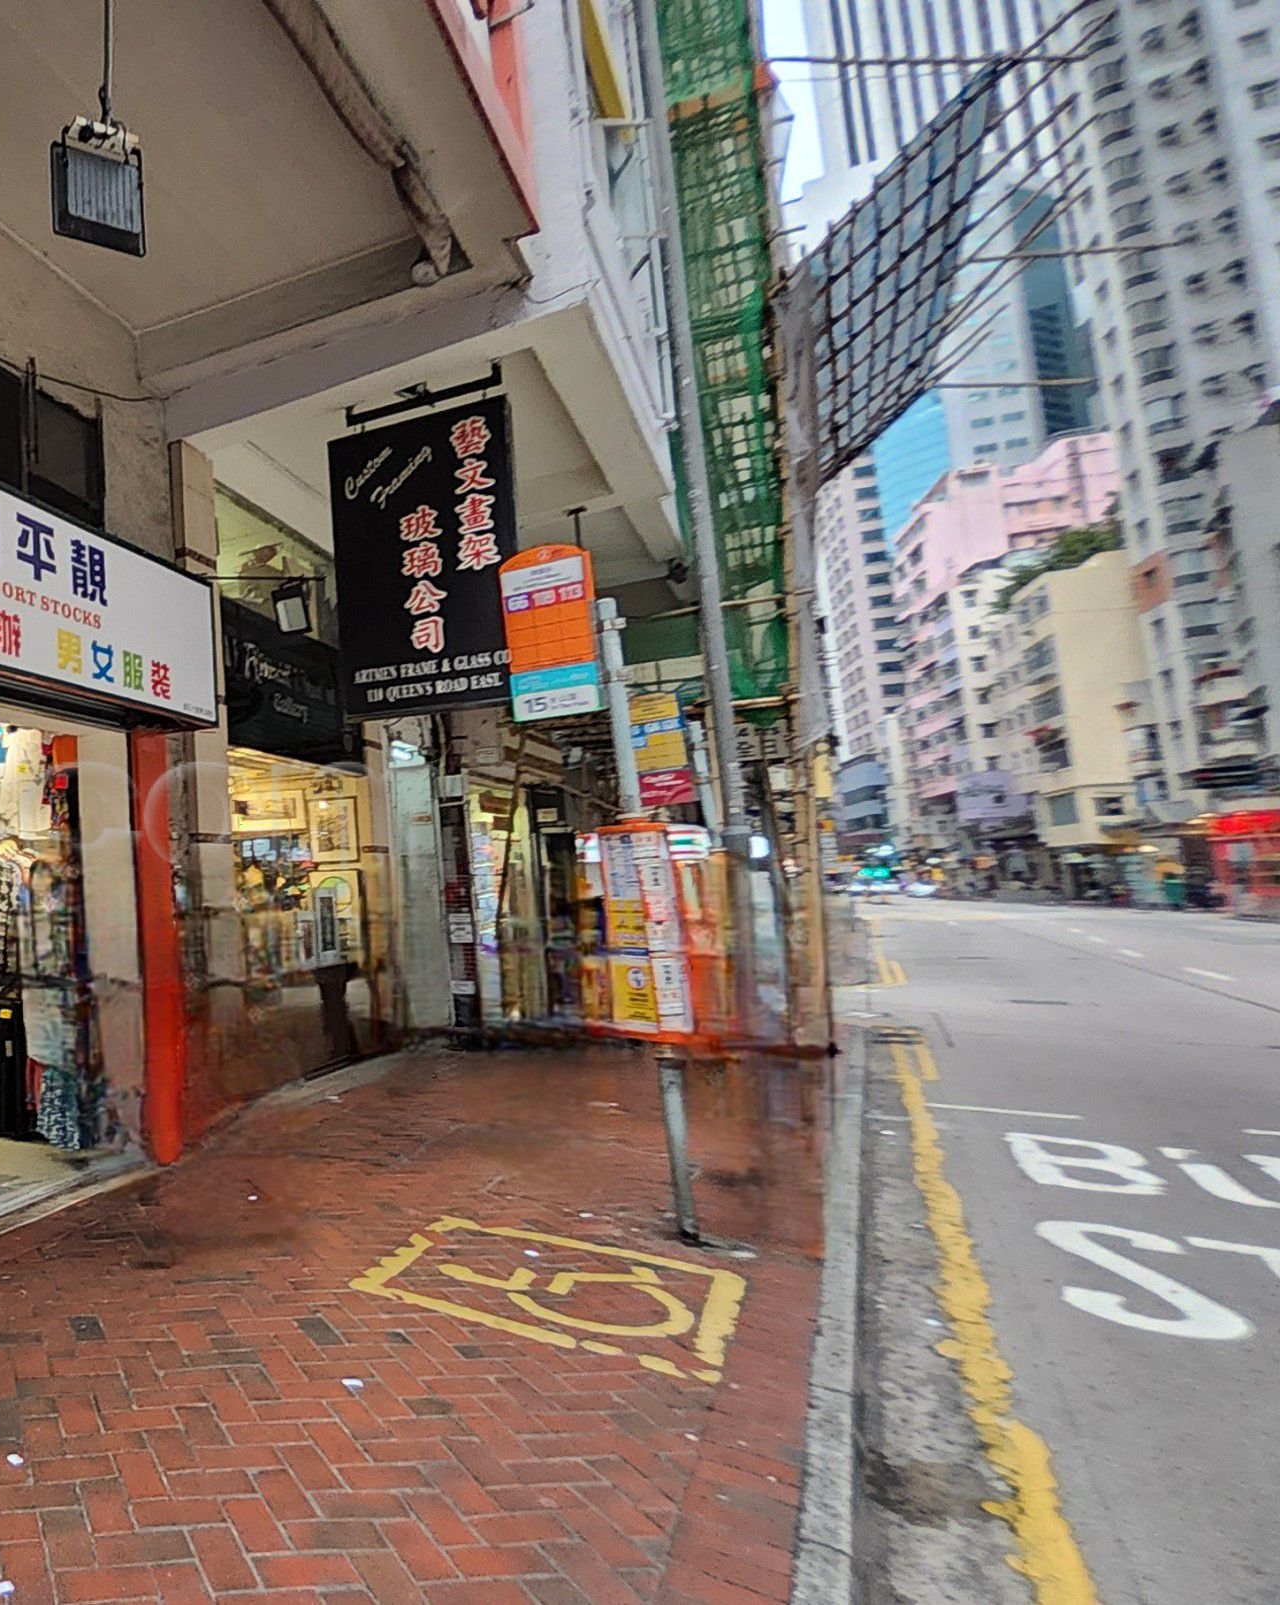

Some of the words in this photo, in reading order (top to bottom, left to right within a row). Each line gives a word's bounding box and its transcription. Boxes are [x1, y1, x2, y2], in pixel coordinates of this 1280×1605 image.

[448, 415, 503, 571] 藝文畫架
[399, 504, 448, 654] 玻璃公司
[40, 594, 102, 629] STOCKS
[56, 627, 171, 701] 男女服裝
[386, 681, 434, 703] QUEEN'S
[435, 676, 469, 695] ROAD
[470, 671, 504, 691] EAST
[400, 659, 439, 678] FRAME
[441, 657, 452, 673] &
[453, 651, 492, 671] GLASS
